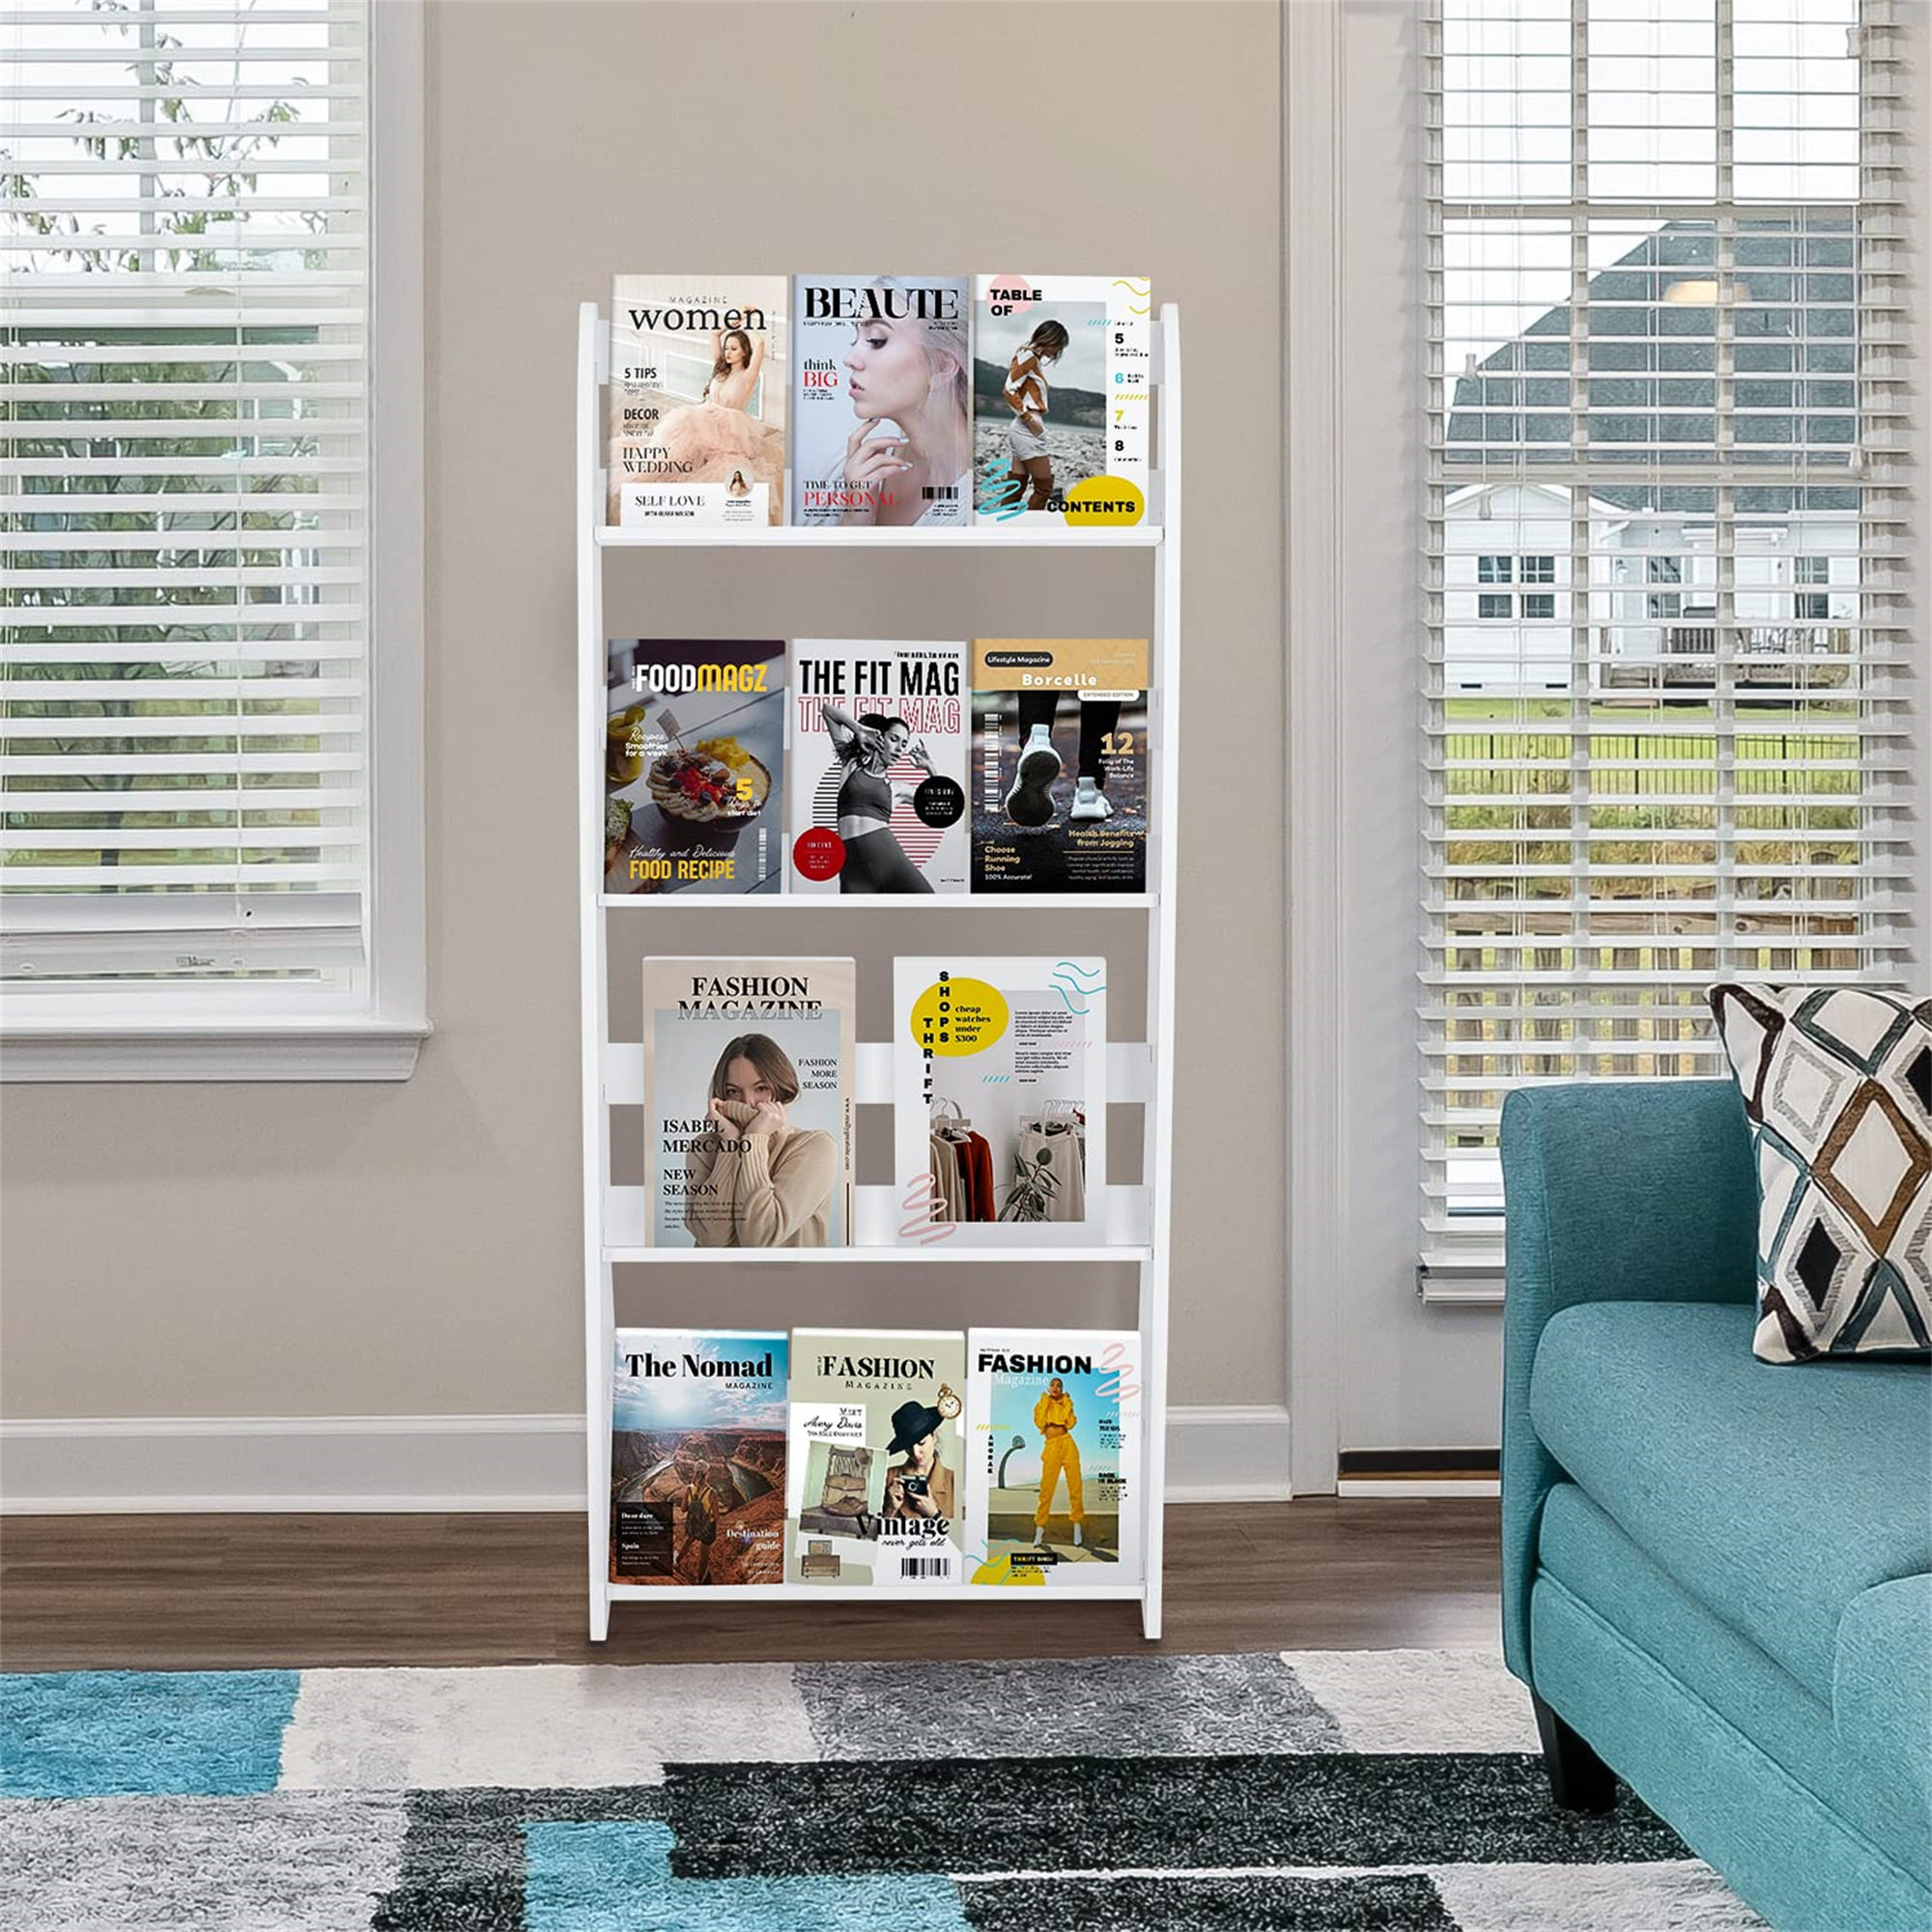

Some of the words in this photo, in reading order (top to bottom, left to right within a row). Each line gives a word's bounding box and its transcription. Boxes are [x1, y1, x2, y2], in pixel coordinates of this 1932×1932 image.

[668, 296, 727, 304] MAGAZINE
[990, 289, 1042, 301] TABLE
[804, 287, 959, 319] BEAUTE
[991, 304, 1014, 317] OF
[628, 308, 767, 330] women
[1115, 332, 1124, 345] 5
[804, 358, 837, 371] think
[624, 367, 631, 379] 5
[635, 367, 658, 379] TIPS
[803, 371, 838, 387] BIG
[1115, 372, 1124, 384] 6
[624, 408, 660, 420] DECOR
[1115, 410, 1123, 421] 7
[1115, 440, 1124, 451] 8
[623, 447, 670, 459] HAPPY
[623, 461, 694, 473] WEDDING
[804, 481, 829, 490] TIME
[832, 481, 846, 490] TO
[849, 481, 872, 490] GET
[635, 496, 668, 506] SELF
[668, 496, 705, 506] LOVE
[803, 492, 899, 507] PERSONAL
[1047, 500, 1136, 513] CONTENTS
[987, 656, 1016, 665] Lifestyle
[1017, 656, 1051, 665] Magazine
[636, 664, 768, 693] FOODMAGZ
[799, 660, 845, 695] THE
[855, 661, 892, 695] FIT
[900, 661, 959, 696] MAG
[1022, 673, 1098, 687] Borcelle
[898, 698, 960, 733] MAG
[1100, 732, 1134, 754] 12
[736, 778, 753, 801] 5
[1100, 838, 1134, 848] Jogging
[629, 844, 668, 860] Healthy
[669, 848, 691, 858] and
[692, 843, 735, 858] Delicious
[984, 855, 1020, 864] Running
[629, 860, 672, 880] FOOD
[677, 860, 735, 880] RECIPE
[692, 977, 810, 997] FASHION
[677, 1000, 823, 1020] MAGAZINE
[939, 971, 951, 1042] SHOPS
[923, 1017, 934, 1104] THRIFT
[802, 1081, 838, 1090] SEASON
[663, 1120, 724, 1133] ISABEL
[663, 1139, 752, 1153] MERCADO
[663, 1169, 696, 1180] NEW
[663, 1184, 718, 1196] SEASON
[625, 1352, 677, 1378] The
[682, 1352, 773, 1378] Nomad
[823, 1355, 934, 1379] FASHION
[979, 1353, 1092, 1374] FASHION
[725, 1381, 773, 1390] MAGAZINE
[993, 1374, 1049, 1388] Magazine
[856, 1512, 950, 1539] Vintage
[726, 1529, 780, 1538] Destination
[755, 1541, 781, 1551] guide
[906, 1539, 926, 1550] gets
